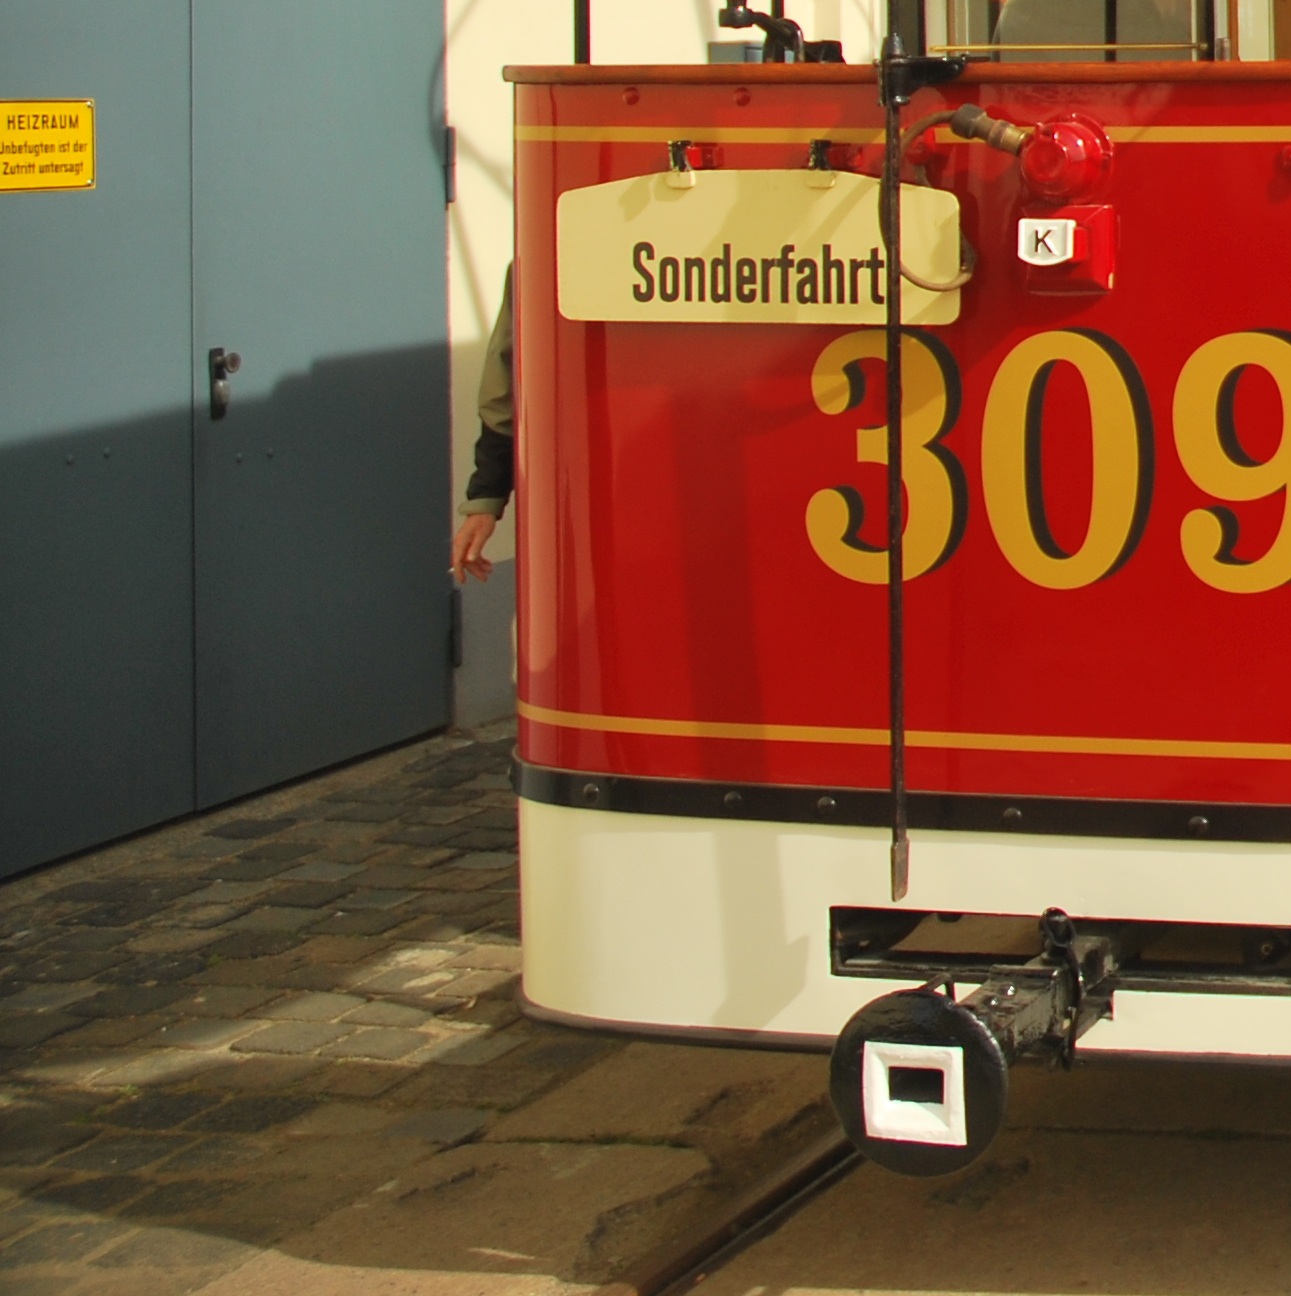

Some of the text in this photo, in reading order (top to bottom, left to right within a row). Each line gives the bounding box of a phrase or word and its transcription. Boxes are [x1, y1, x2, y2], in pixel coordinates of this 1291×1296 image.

[7, 114, 80, 130] HEIZRAUM
[59, 140, 71, 153] ist
[73, 140, 88, 153] der
[3, 160, 84, 175] Zutritt untersagt
[1034, 228, 1054, 255] K
[632, 241, 885, 305] Sonderfahrt
